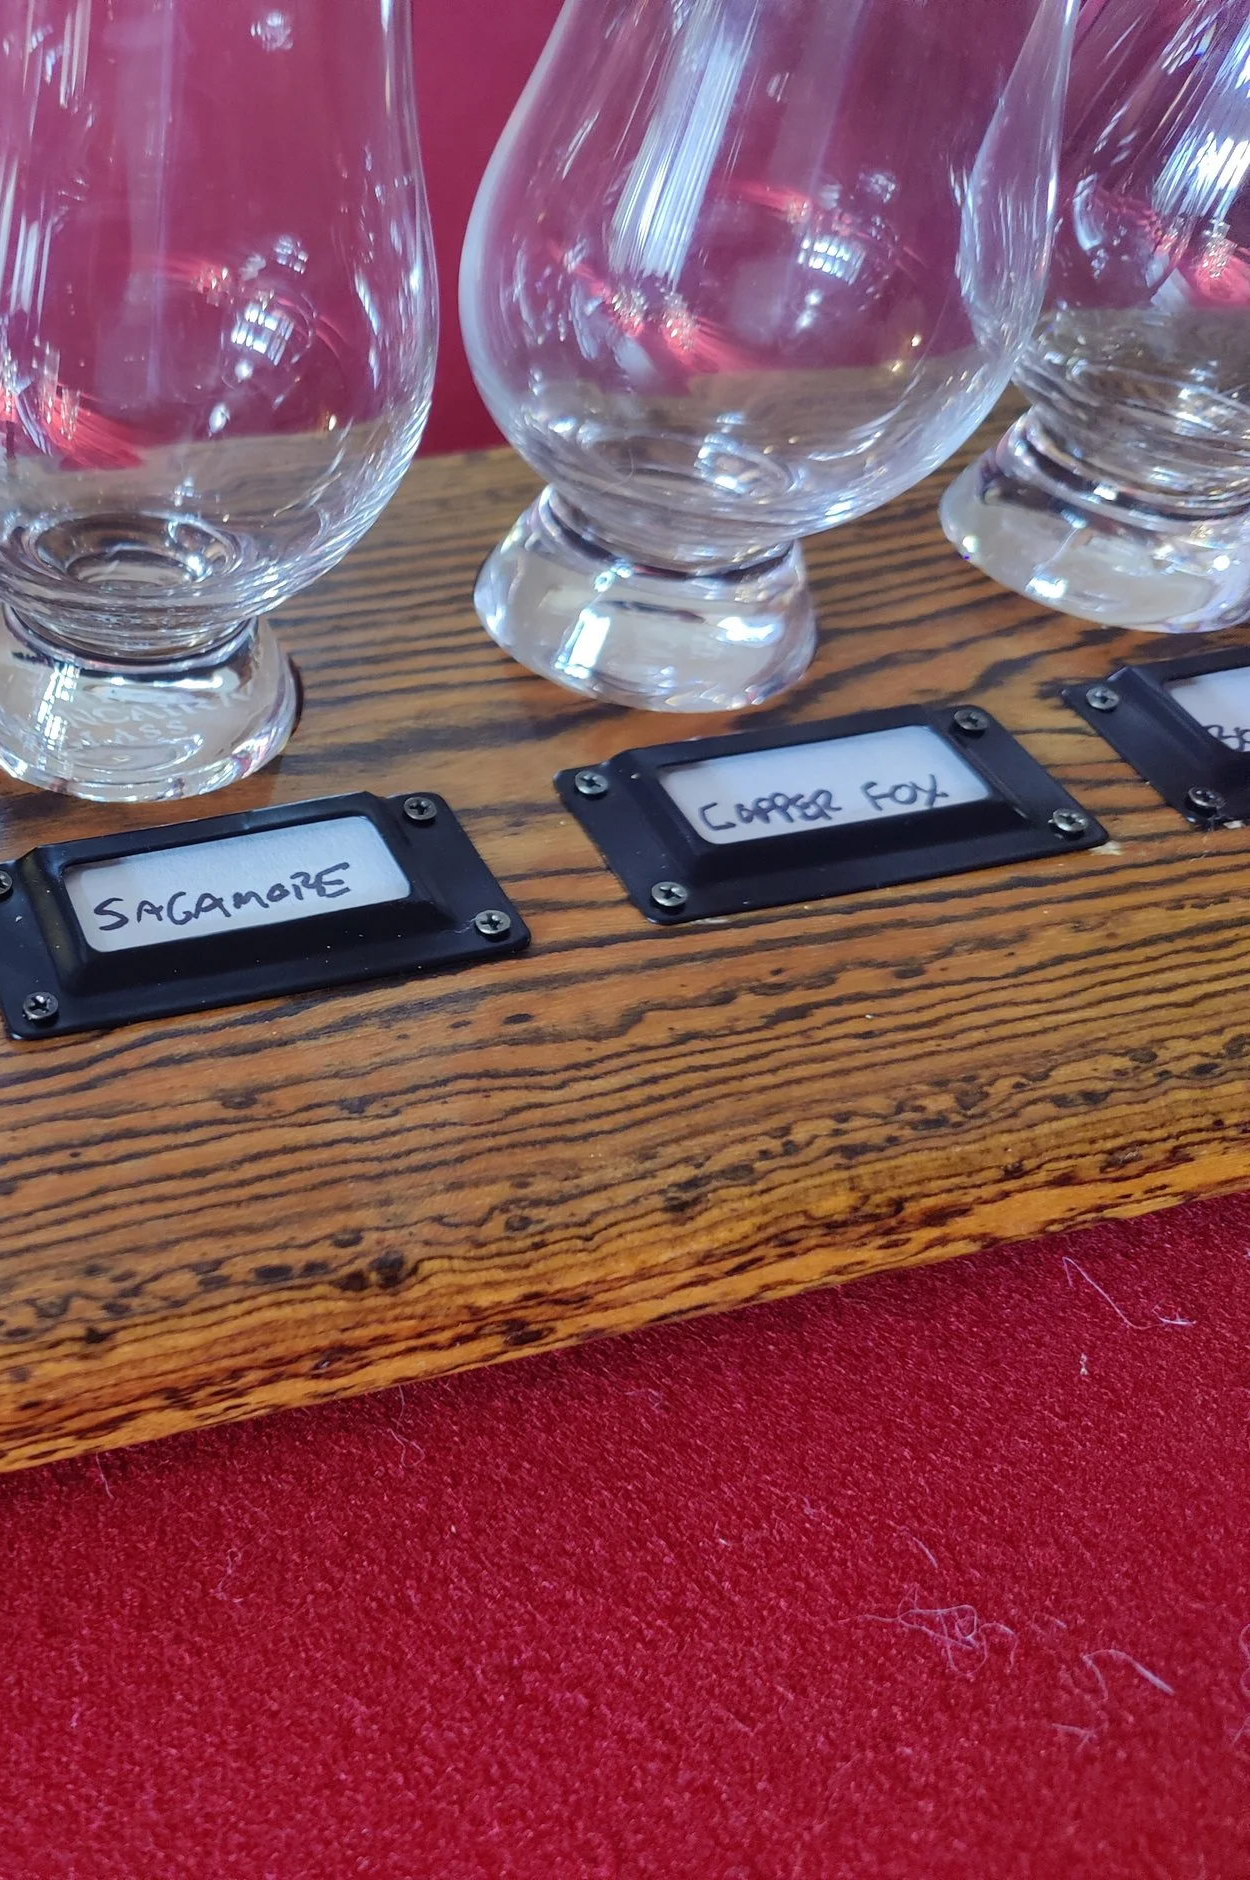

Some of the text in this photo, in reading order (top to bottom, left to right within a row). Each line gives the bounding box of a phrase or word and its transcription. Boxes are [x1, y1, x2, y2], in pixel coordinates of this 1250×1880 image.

[698, 773, 949, 832] COPPER FOX
[93, 861, 351, 932] SAGAMORE
